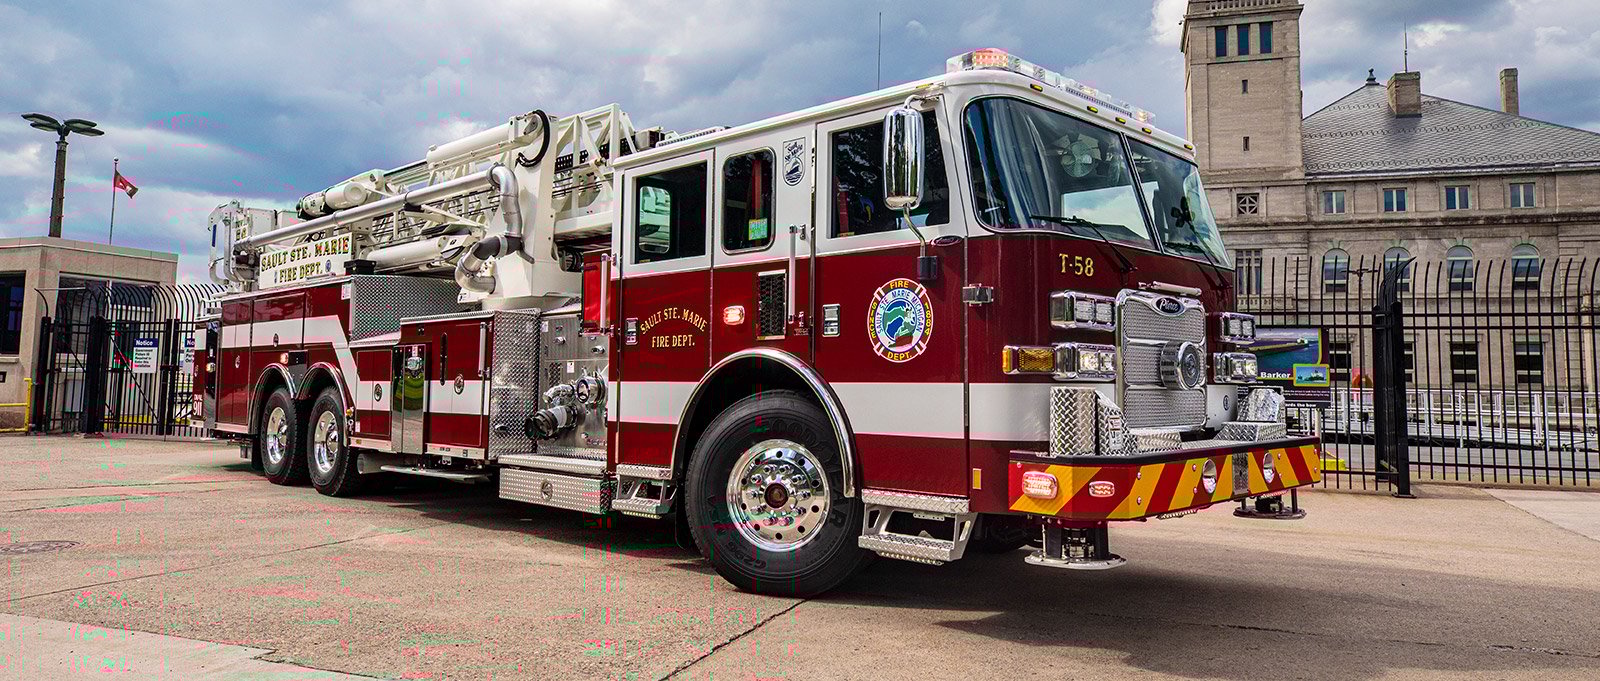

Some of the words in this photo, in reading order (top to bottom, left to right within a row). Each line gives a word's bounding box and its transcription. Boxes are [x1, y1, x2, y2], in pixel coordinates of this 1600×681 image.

[261, 251, 288, 272] SAULT
[290, 246, 311, 262] STE.
[315, 236, 349, 256] MARIE
[279, 266, 297, 283] FIRE
[299, 262, 323, 280] DEPT.
[889, 280, 910, 289] FIRE
[640, 311, 662, 335] SAULT
[663, 307, 681, 320] STE.
[681, 309, 708, 332] MARIE
[869, 301, 877, 338] SINCE
[880, 297, 889, 309] STE
[891, 290, 911, 299] MARIE
[912, 296, 925, 333] MICHIGAN
[924, 302, 932, 335] 1884
[651, 335, 670, 348] FIRE
[671, 334, 696, 347] DEPT.
[887, 351, 912, 360] DEPT.
[193, 401, 202, 416] 911
